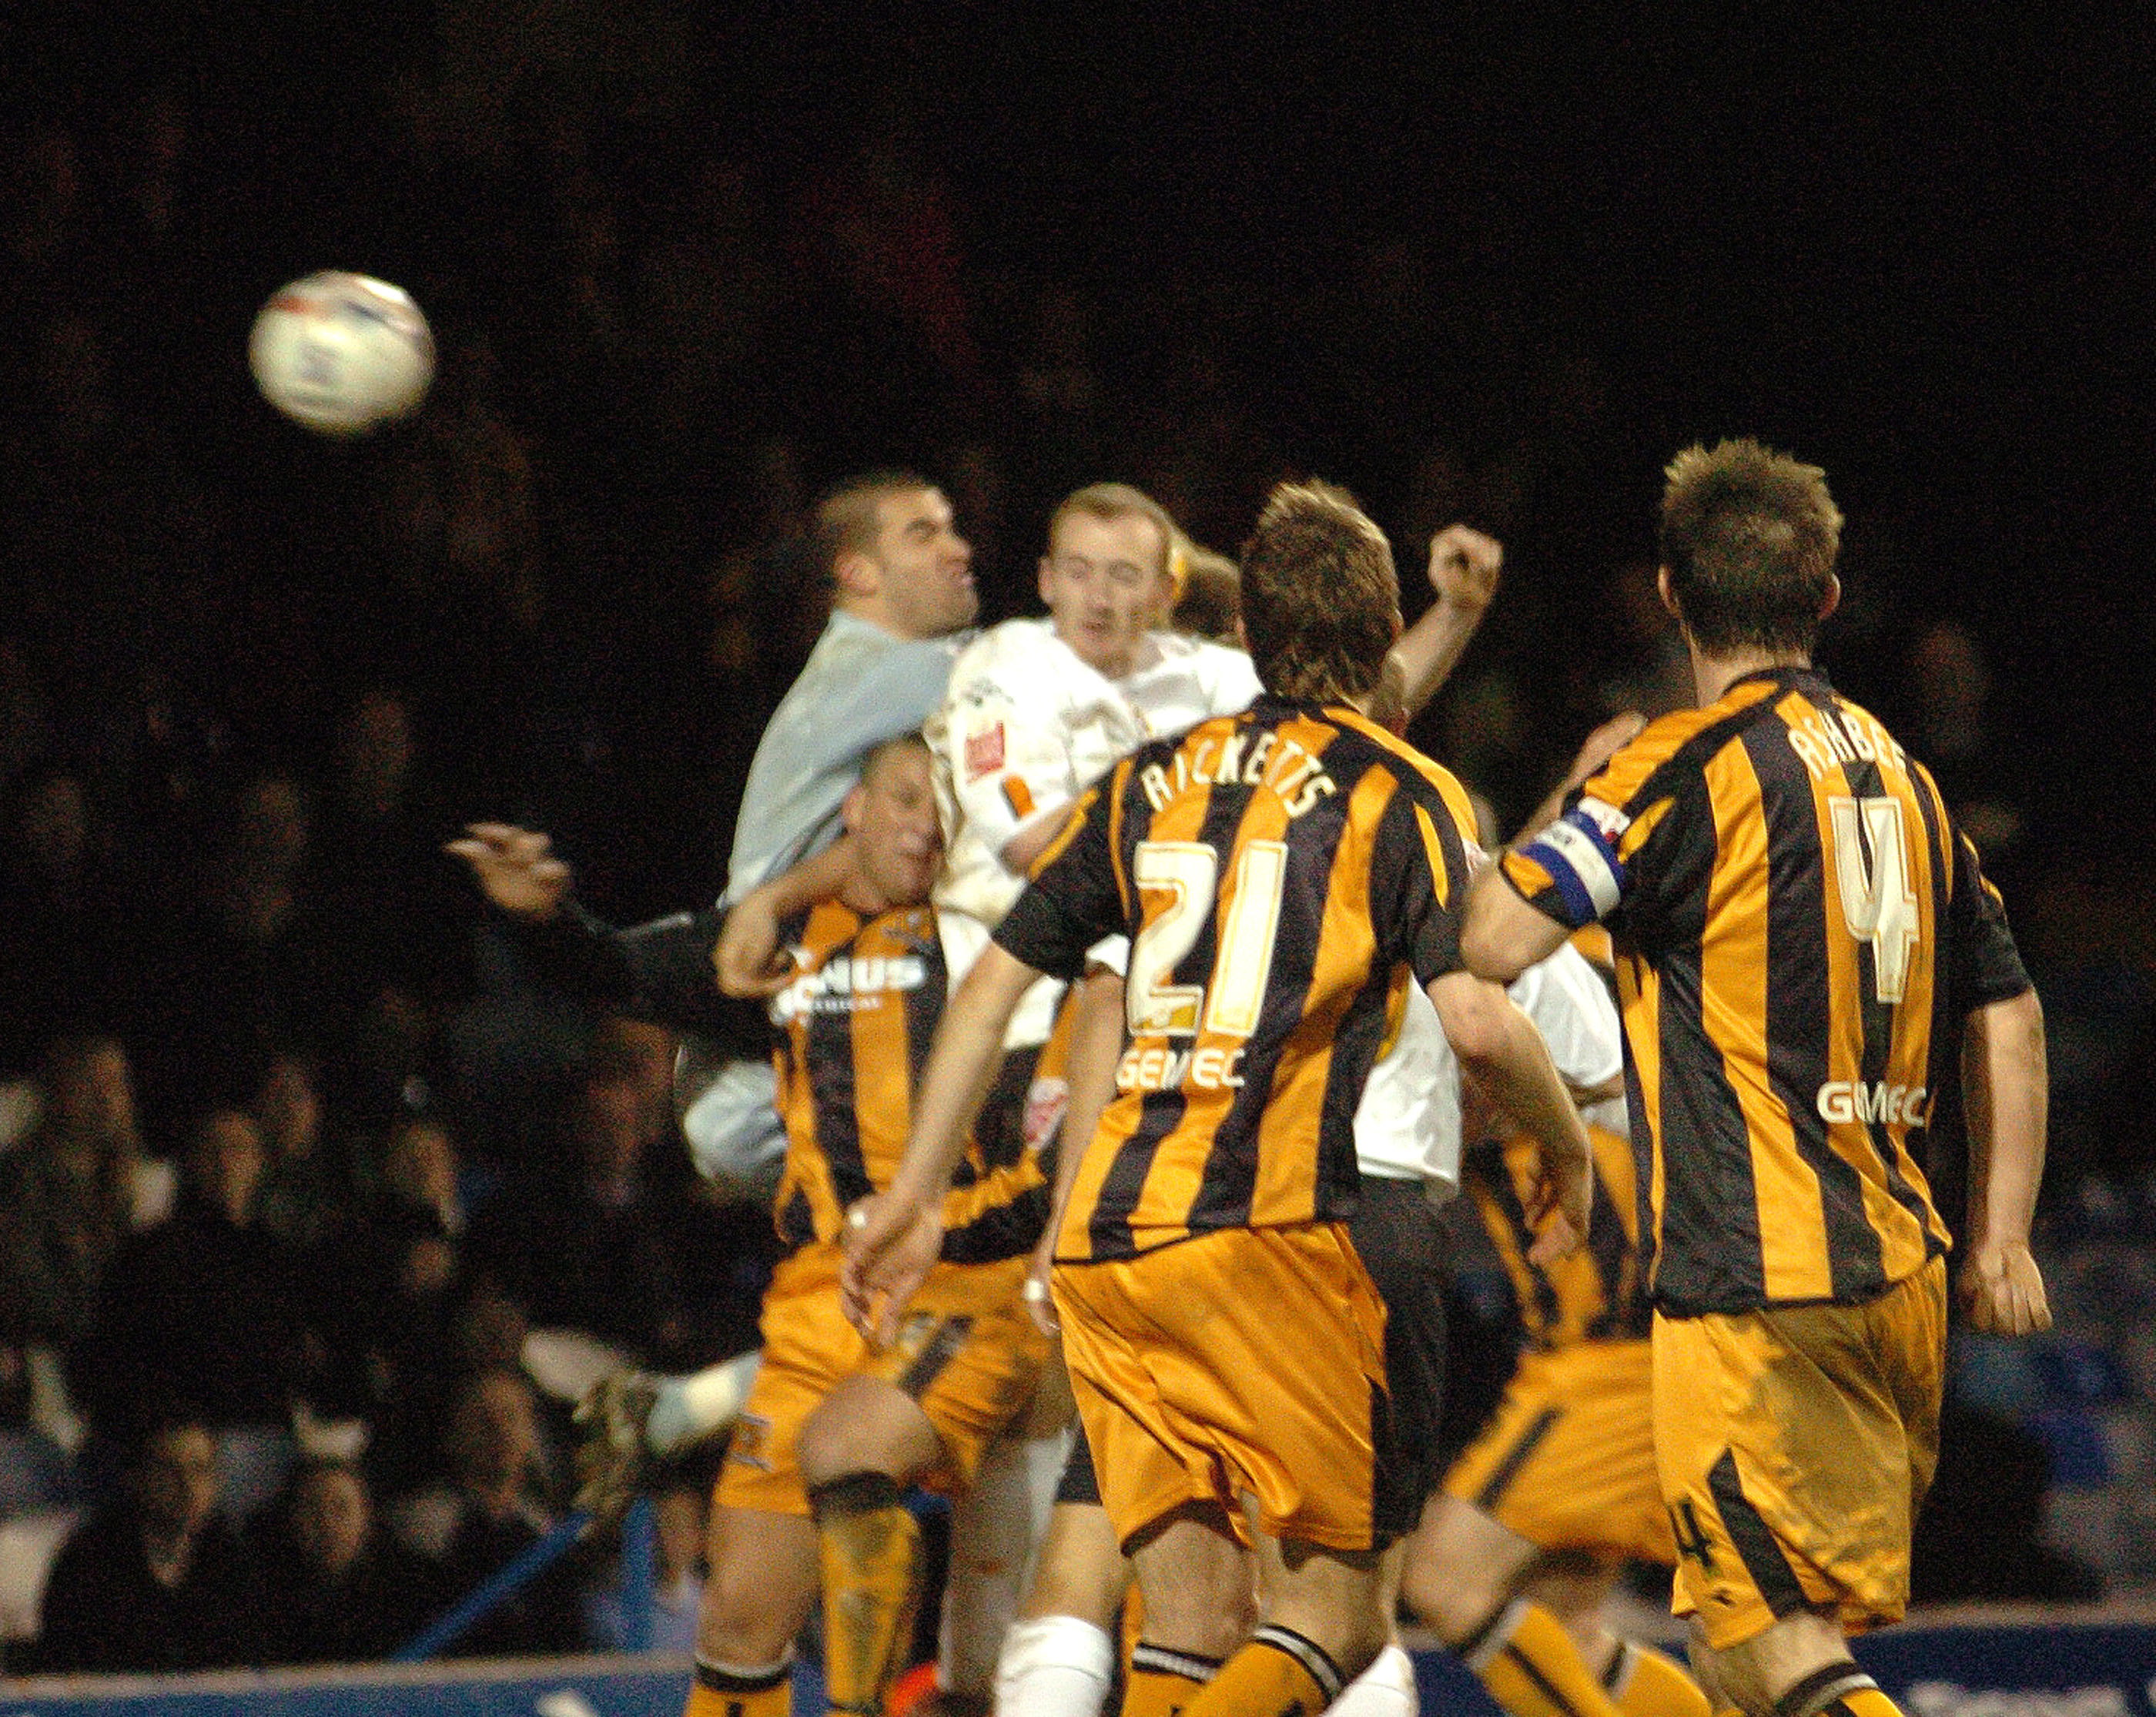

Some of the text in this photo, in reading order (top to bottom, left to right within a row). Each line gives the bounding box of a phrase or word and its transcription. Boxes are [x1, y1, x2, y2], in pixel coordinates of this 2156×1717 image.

[1141, 731, 1337, 818] RICKETTS
[1127, 839, 1288, 1037] 21
[1828, 796, 1919, 1004] 4
[1116, 1048, 1246, 1089] GEMEC
